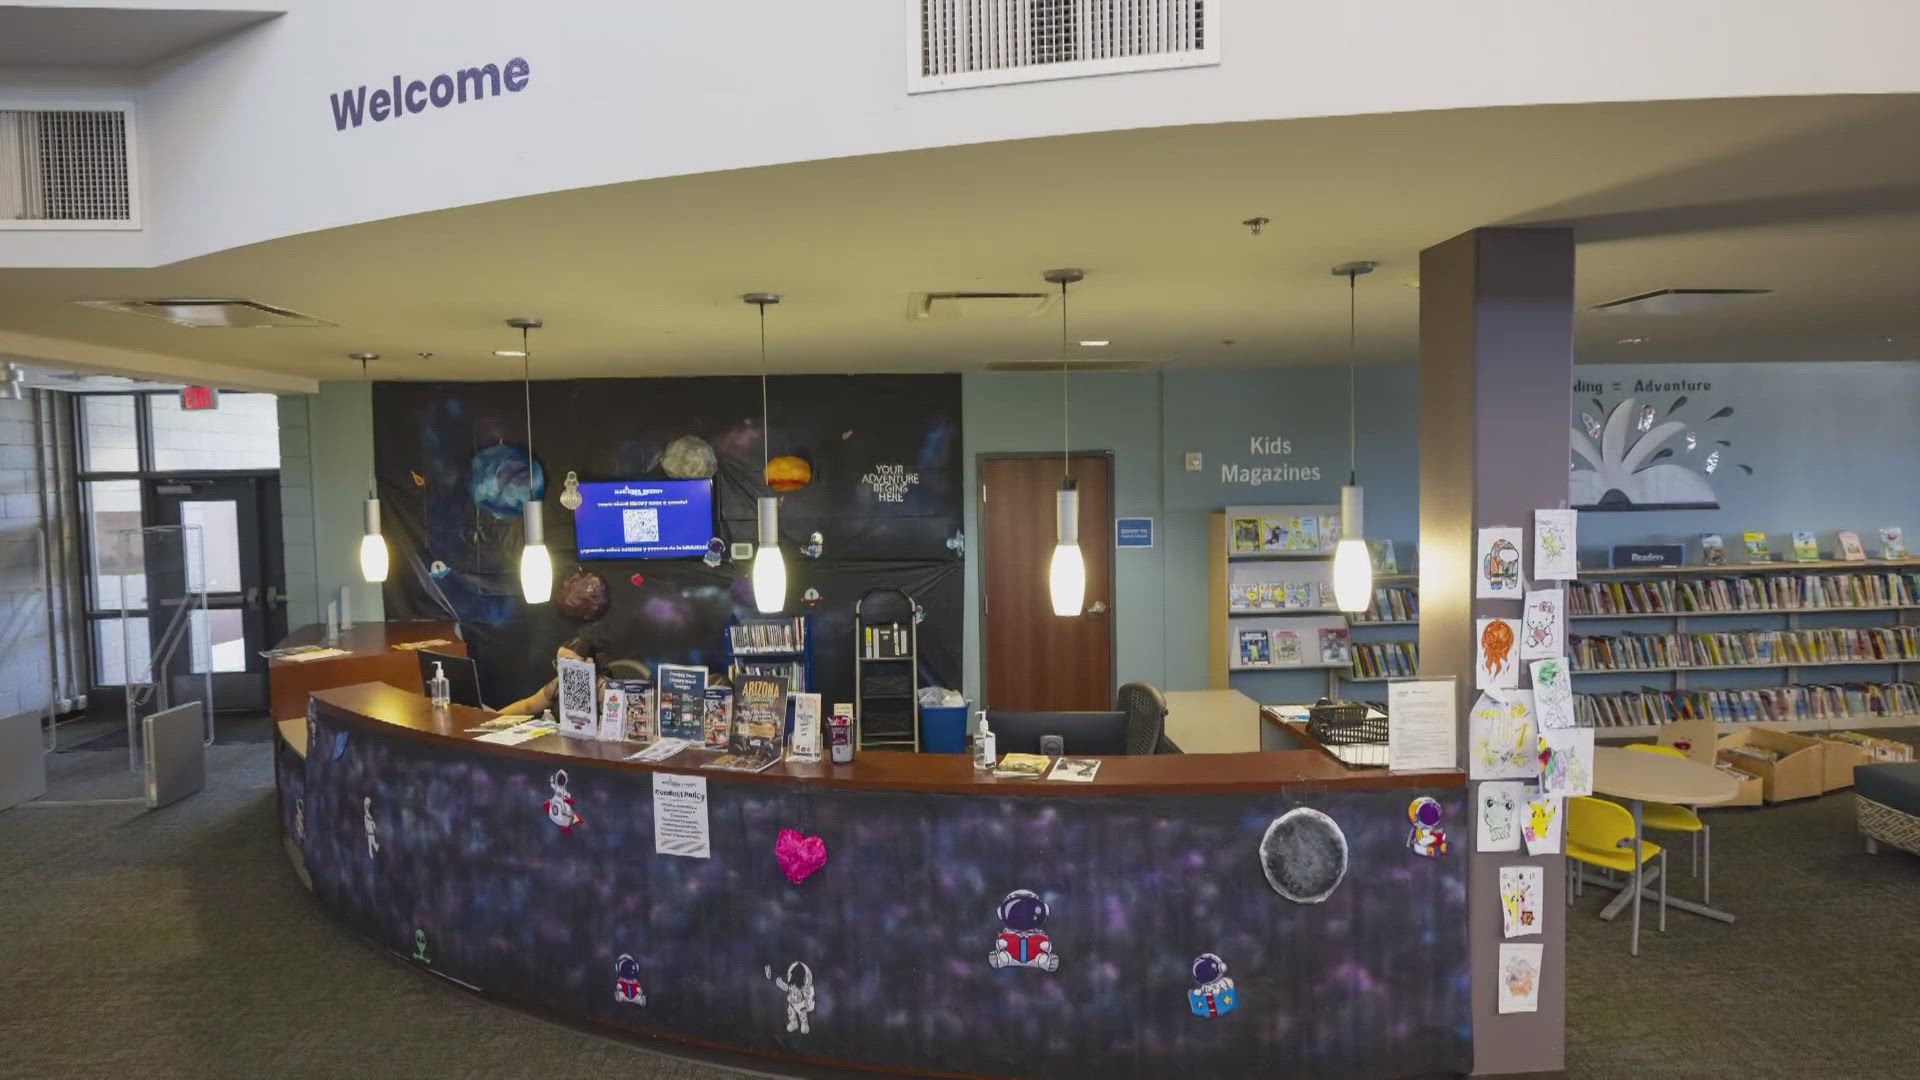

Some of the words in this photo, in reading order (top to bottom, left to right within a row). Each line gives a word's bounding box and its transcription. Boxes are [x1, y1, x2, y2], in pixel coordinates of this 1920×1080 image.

[330, 57, 530, 131] Welcome
[1573, 379, 1603, 395] ding
[1634, 379, 1712, 393] Adventure
[1250, 436, 1292, 455] Kids
[876, 465, 904, 474] YOUR
[1221, 463, 1321, 486] Magazines
[861, 473, 920, 485] ADVENTURE
[873, 482, 909, 494] BEGINS
[879, 493, 904, 502] HERE
[1631, 553, 1665, 562] Readers
[742, 681, 780, 699] ARIZONA
[655, 789, 684, 798] Conduct
